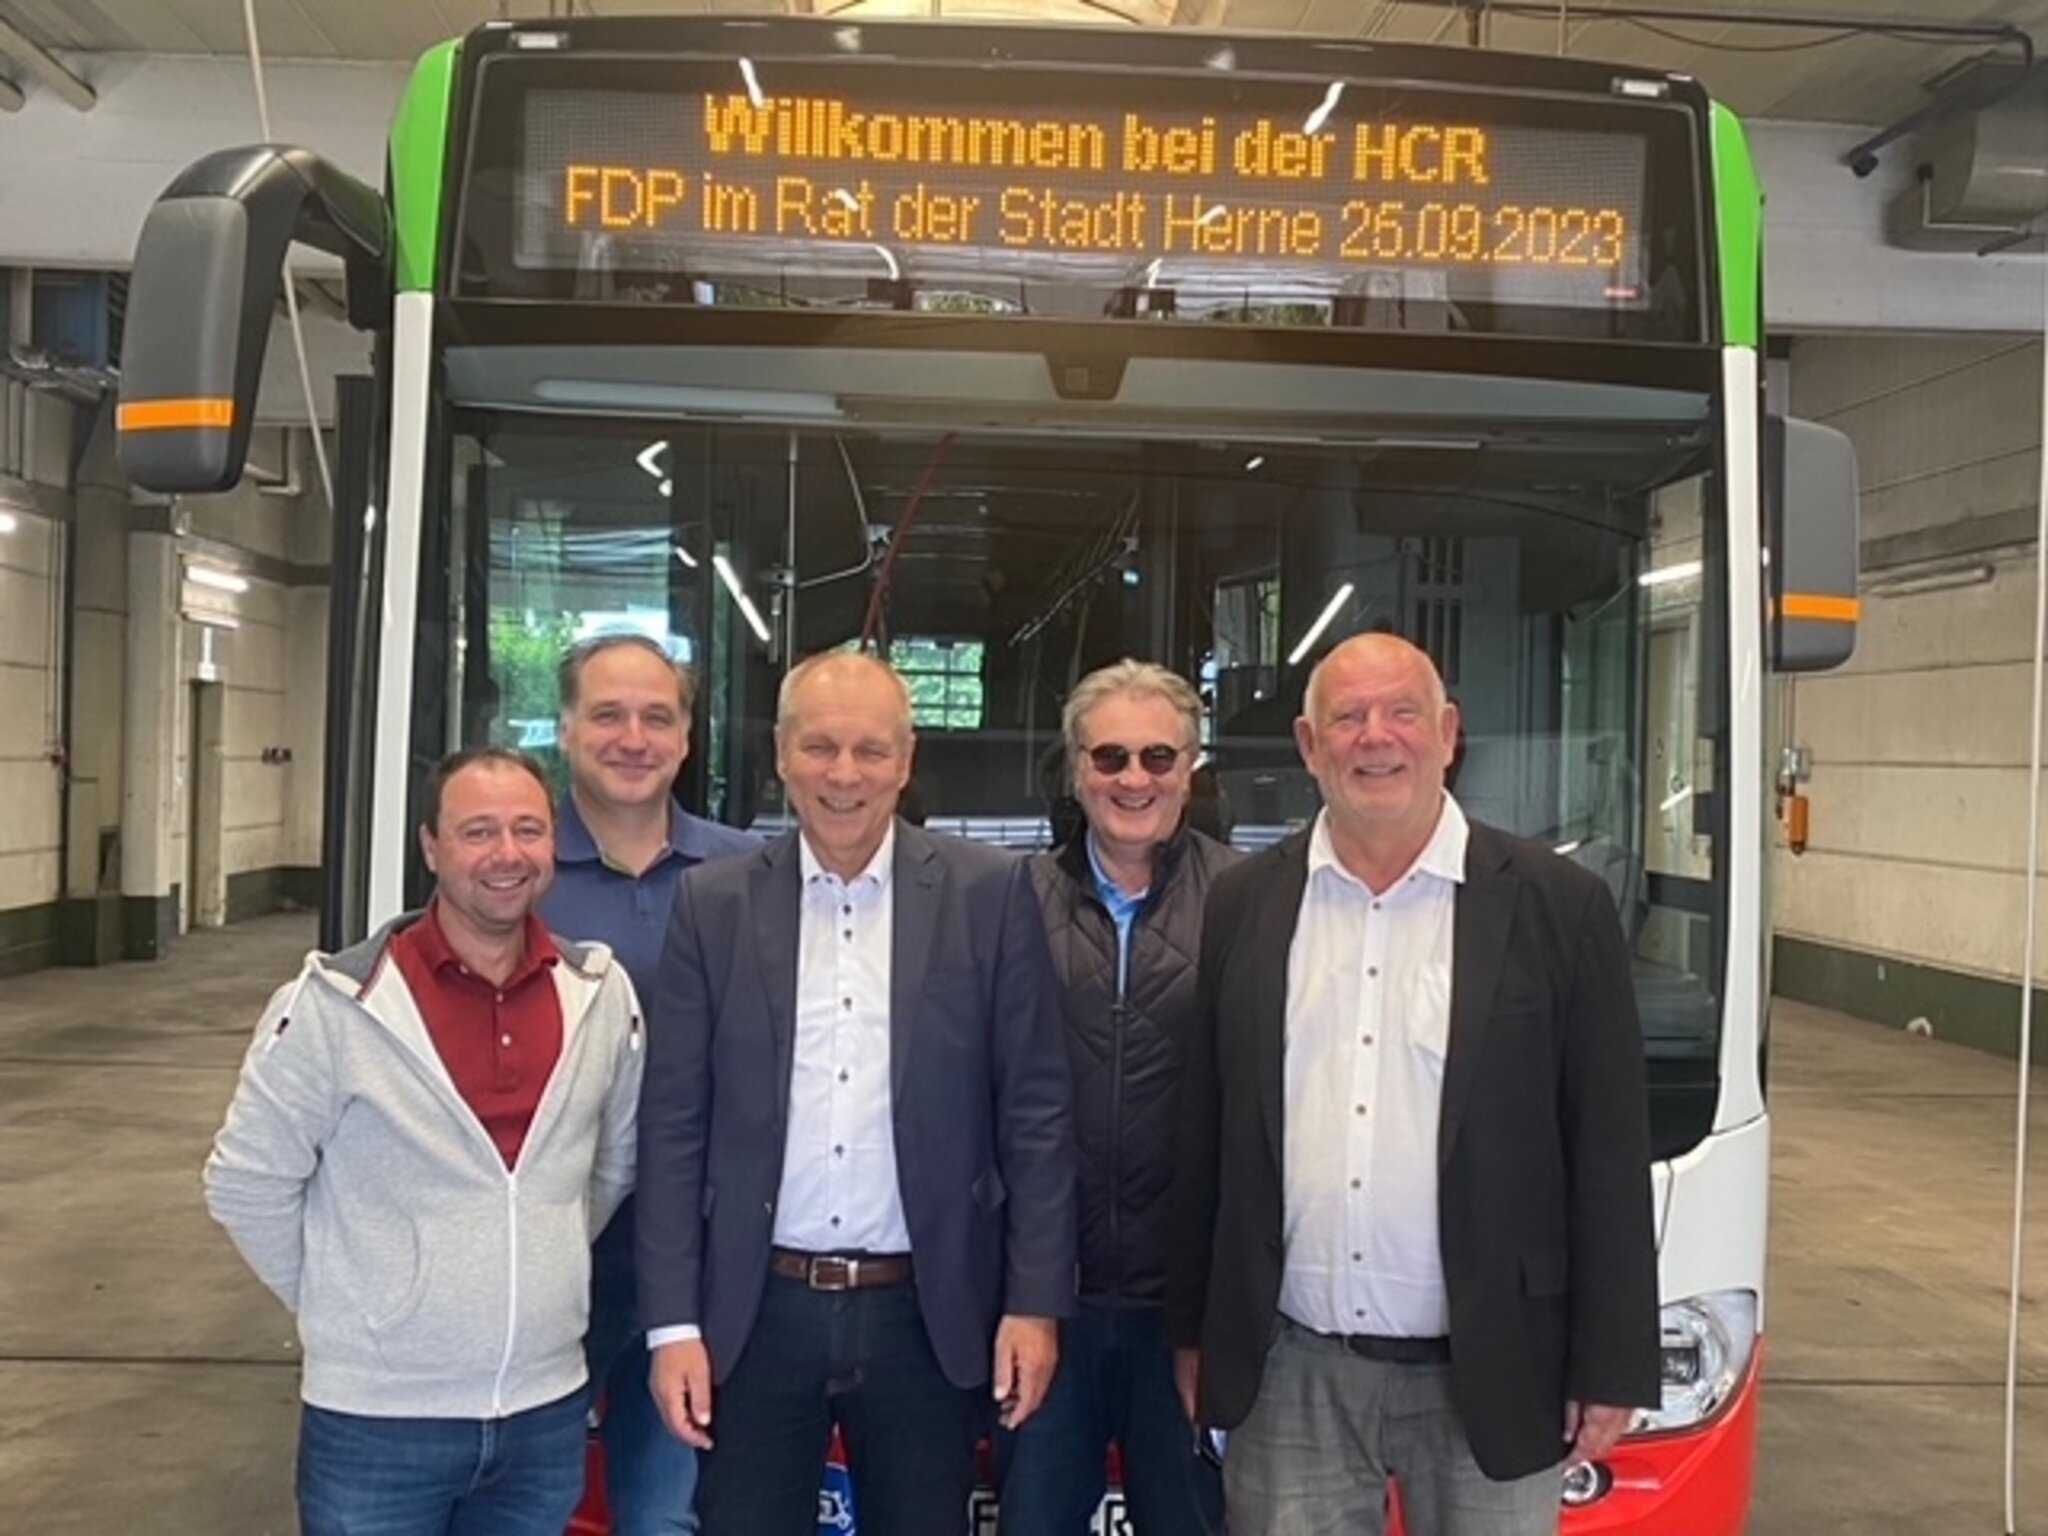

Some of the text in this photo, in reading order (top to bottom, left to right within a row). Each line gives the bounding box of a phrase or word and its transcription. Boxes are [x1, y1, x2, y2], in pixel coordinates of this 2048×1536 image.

[704, 94, 1488, 184] Willkommen bei der HCR
[565, 165, 1626, 266] FDP im Rat der Stadt Herne 25.09.2023
